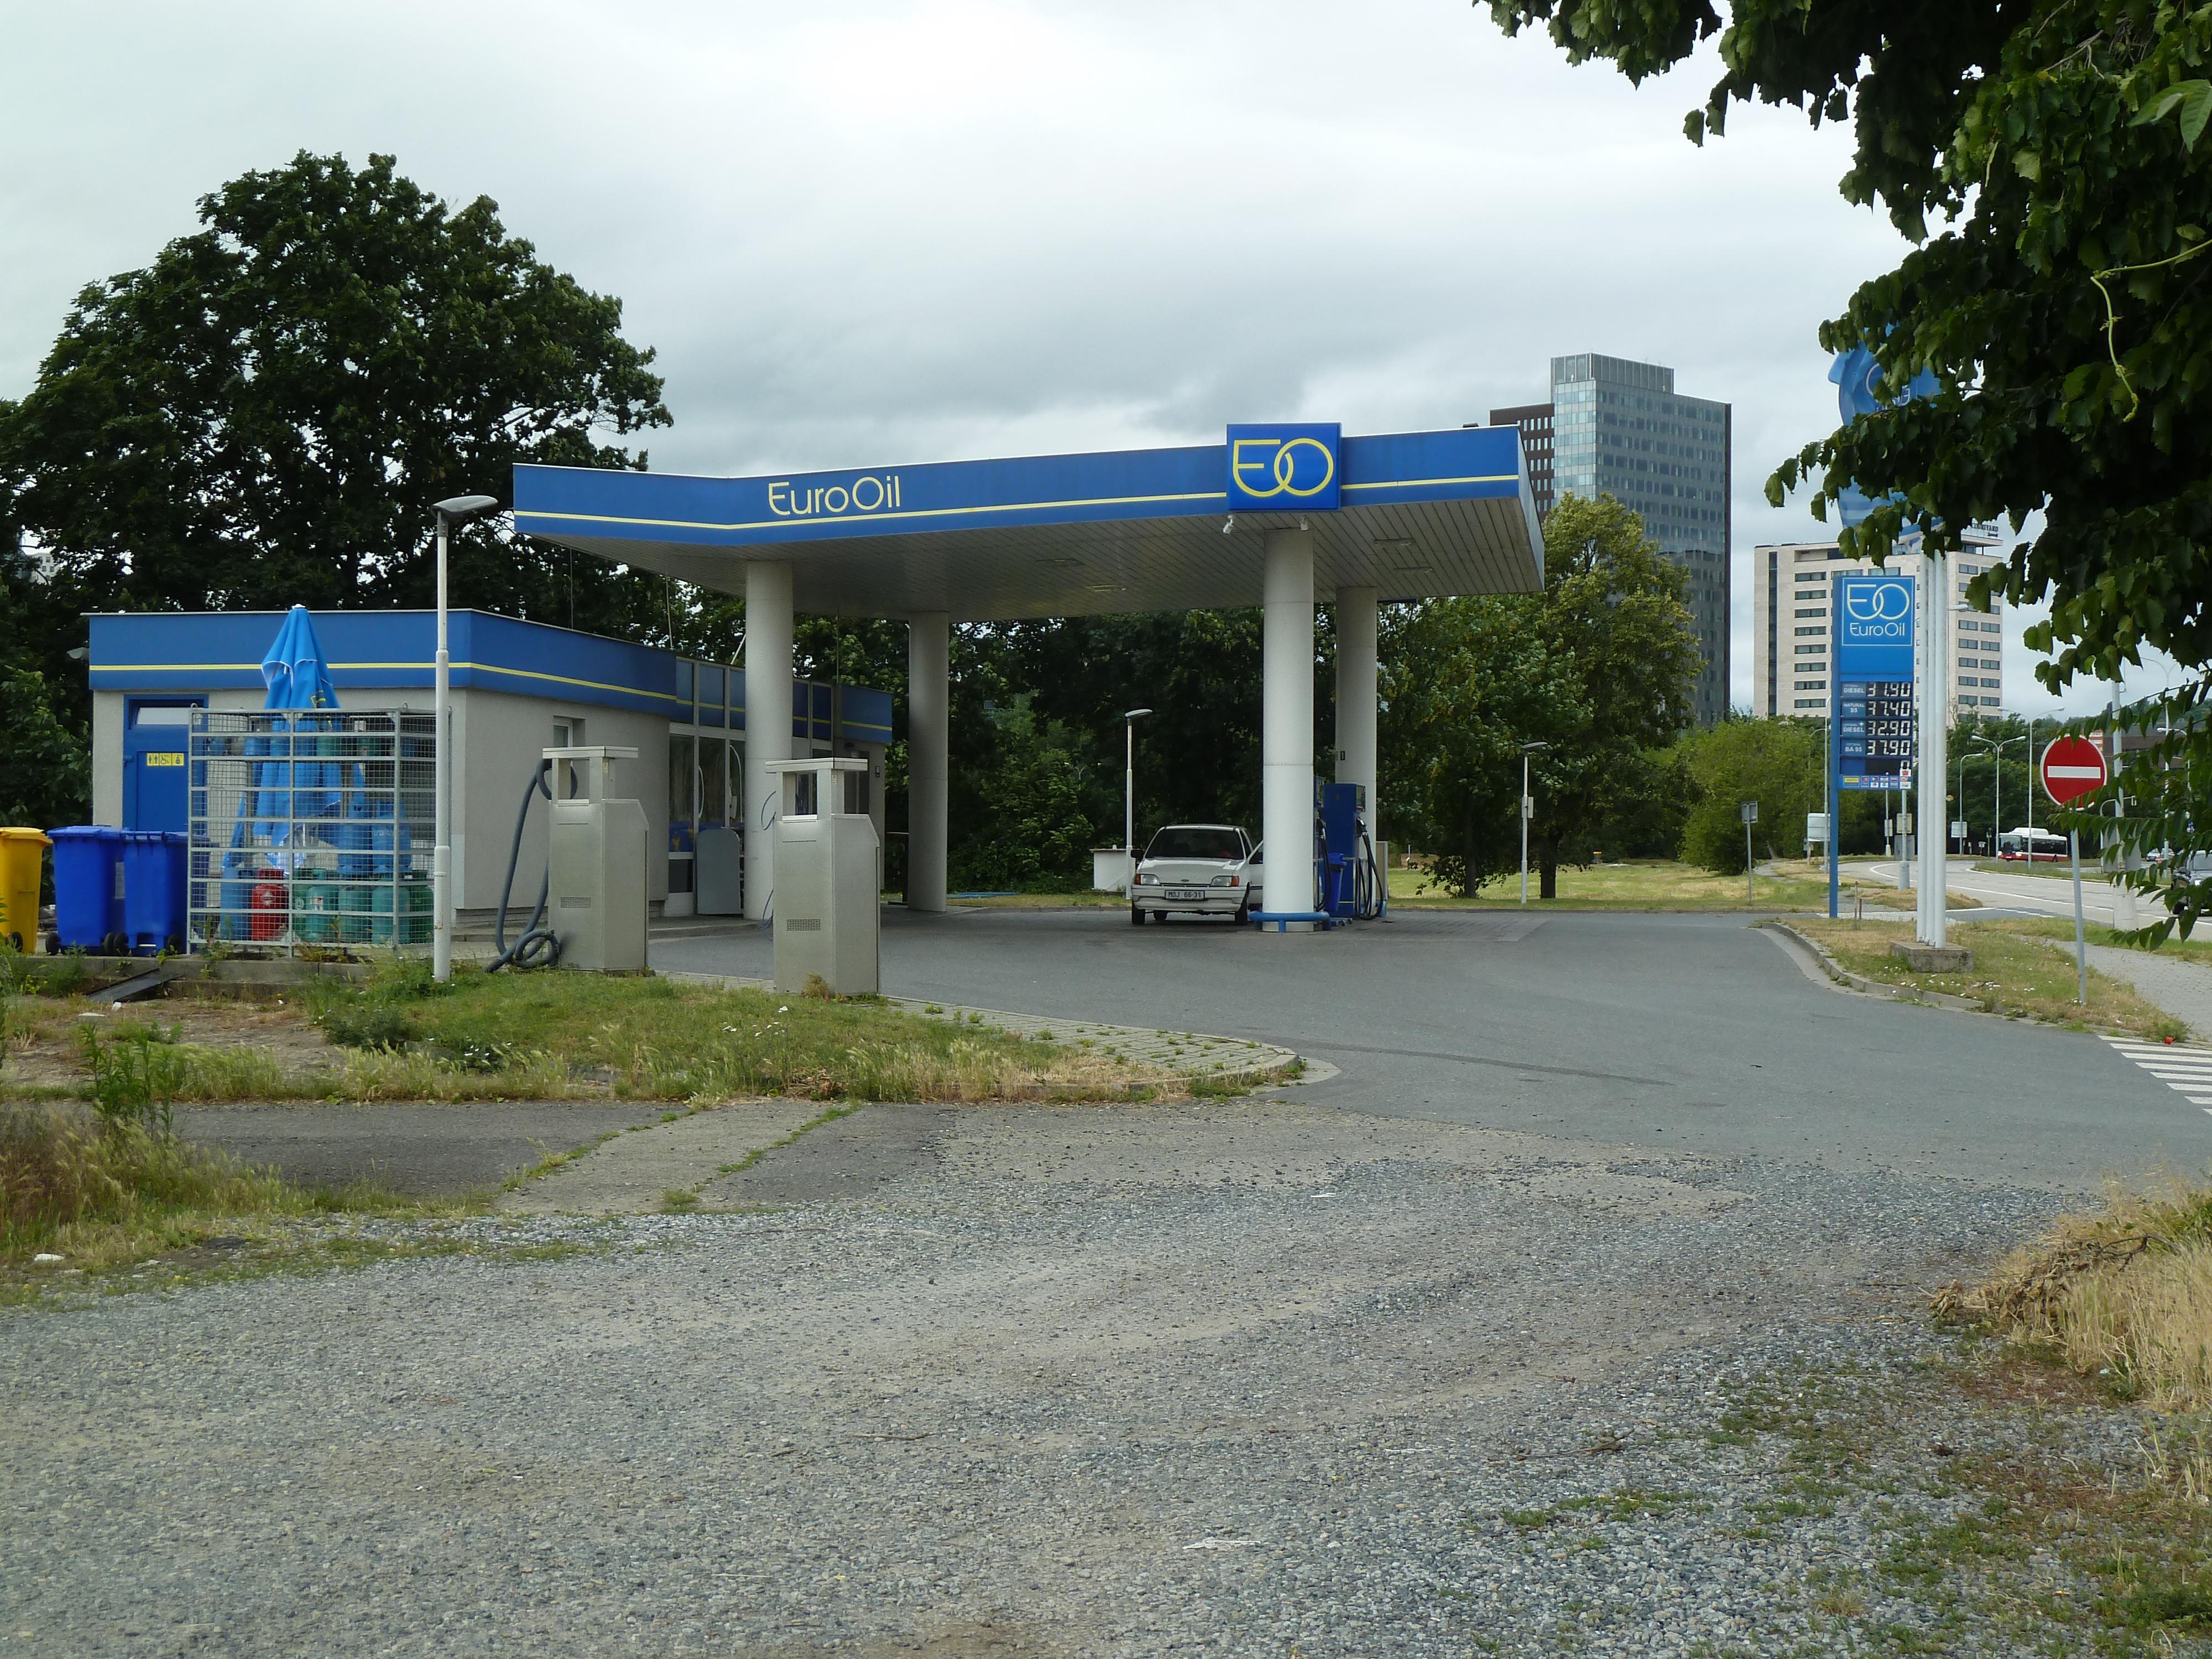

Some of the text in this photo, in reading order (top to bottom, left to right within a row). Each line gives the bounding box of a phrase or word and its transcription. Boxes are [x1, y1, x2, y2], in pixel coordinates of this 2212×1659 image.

[768, 475, 901, 515] EuroOil
[1850, 622, 1905, 636] EuroOil
[1867, 682, 1911, 697] 31.90
[1867, 701, 1911, 716] 37.40
[1867, 721, 1911, 735] 32.90
[1866, 740, 1911, 755] 37.90
